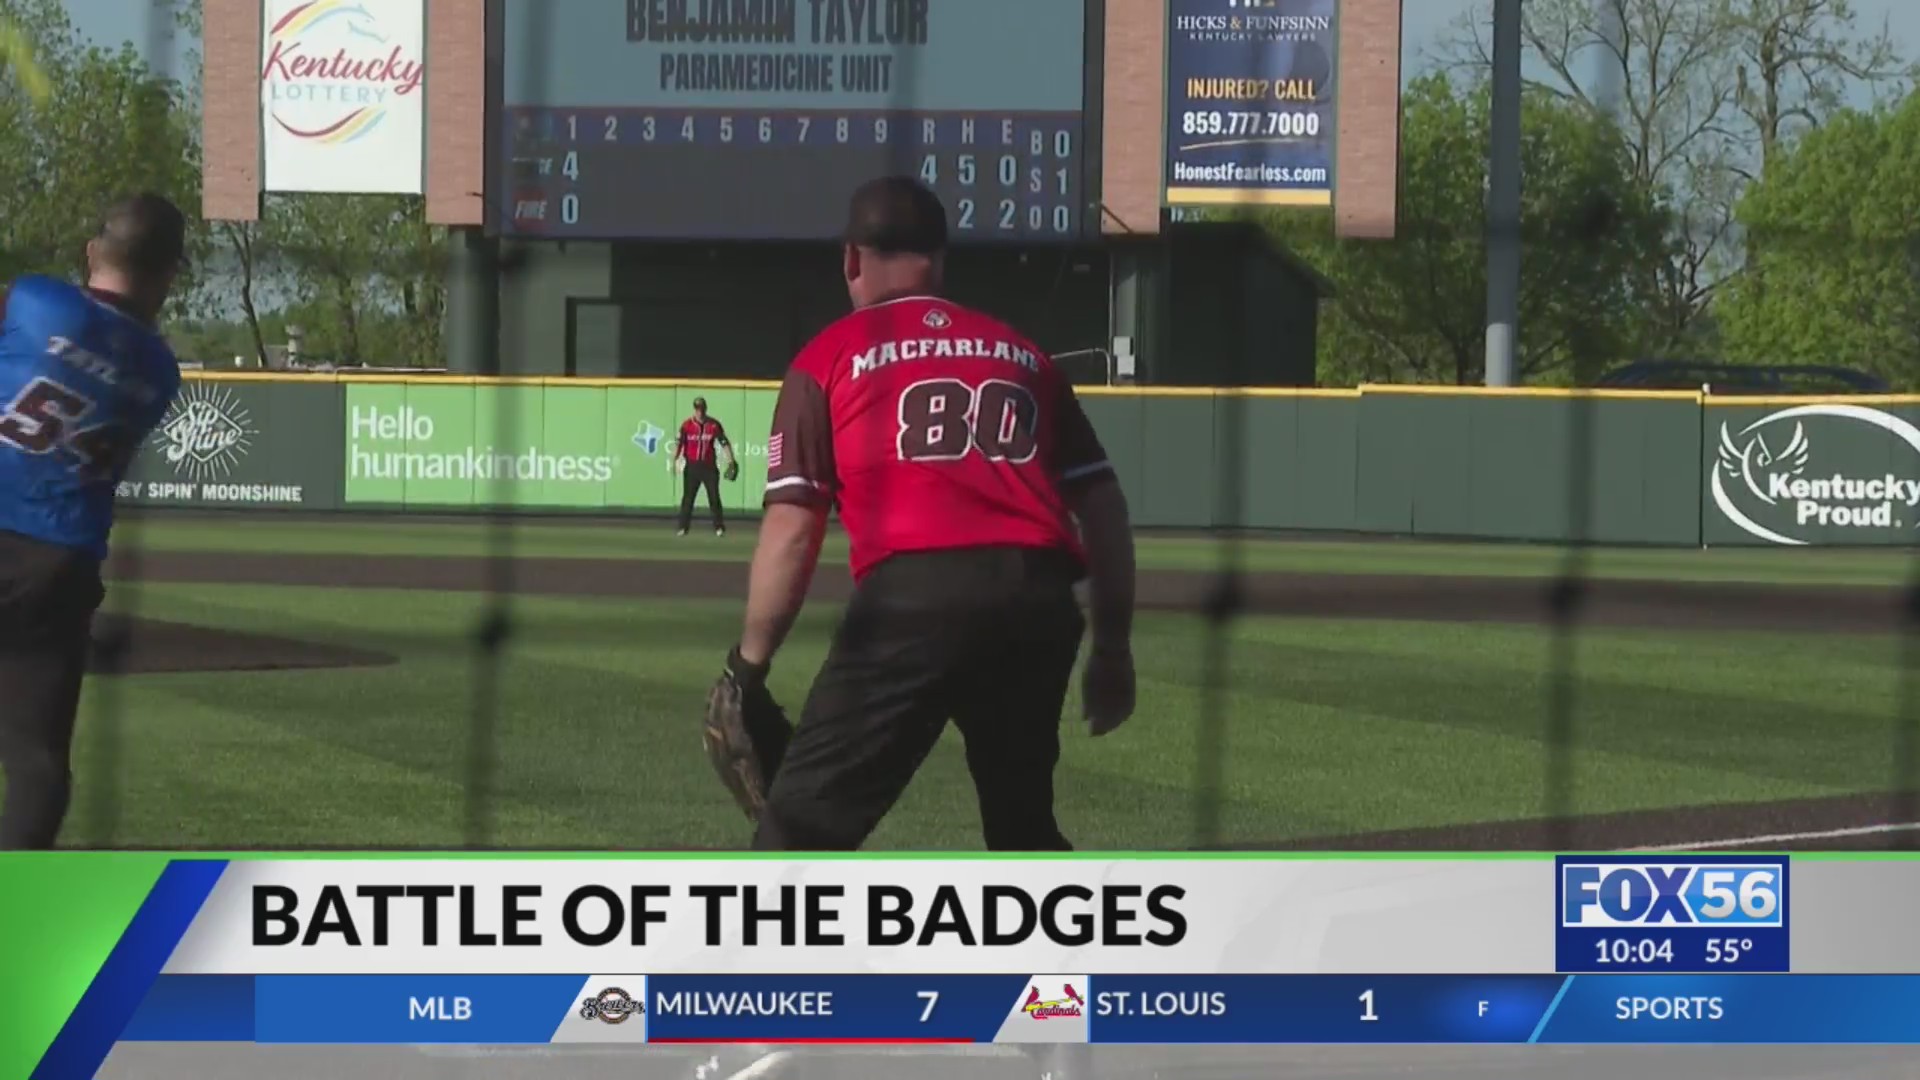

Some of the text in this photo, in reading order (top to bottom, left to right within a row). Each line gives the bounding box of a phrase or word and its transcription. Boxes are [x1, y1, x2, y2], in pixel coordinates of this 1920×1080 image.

[626, 0, 929, 45] BENJAMIN TAYLOR
[1176, 15, 1330, 31] HICKS & FUNFSINN
[1189, 32, 1317, 42] KENTUCKY LAWYERS
[263, 40, 425, 96] Kentucky
[659, 52, 893, 93] PARAMEDICINE UNIT
[271, 84, 387, 104] LOTTERY
[1187, 77, 1317, 101] INJURED? CALL
[568, 115, 1013, 145] 1 2 3 4 5 6 7 8 9 R H E
[1182, 111, 1320, 136] 859.777.7000
[1030, 130, 1043, 156] B
[562, 150, 579, 181] 4
[920, 154, 938, 185] 4
[958, 154, 976, 186] 5
[999, 154, 1017, 186] 0
[1030, 167, 1067, 195] S 1
[1174, 161, 1326, 182] HonestFearless.com
[561, 193, 579, 224] 0
[957, 198, 975, 229] 2
[999, 198, 1016, 229] 2
[188, 400, 219, 434] Sip
[351, 404, 434, 441] Hello
[896, 378, 1038, 464] 80
[167, 418, 239, 462] Shine
[148, 482, 197, 500] SIPIN'
[201, 482, 303, 502] MOONSHINE
[1768, 472, 1920, 506] Kentucky
